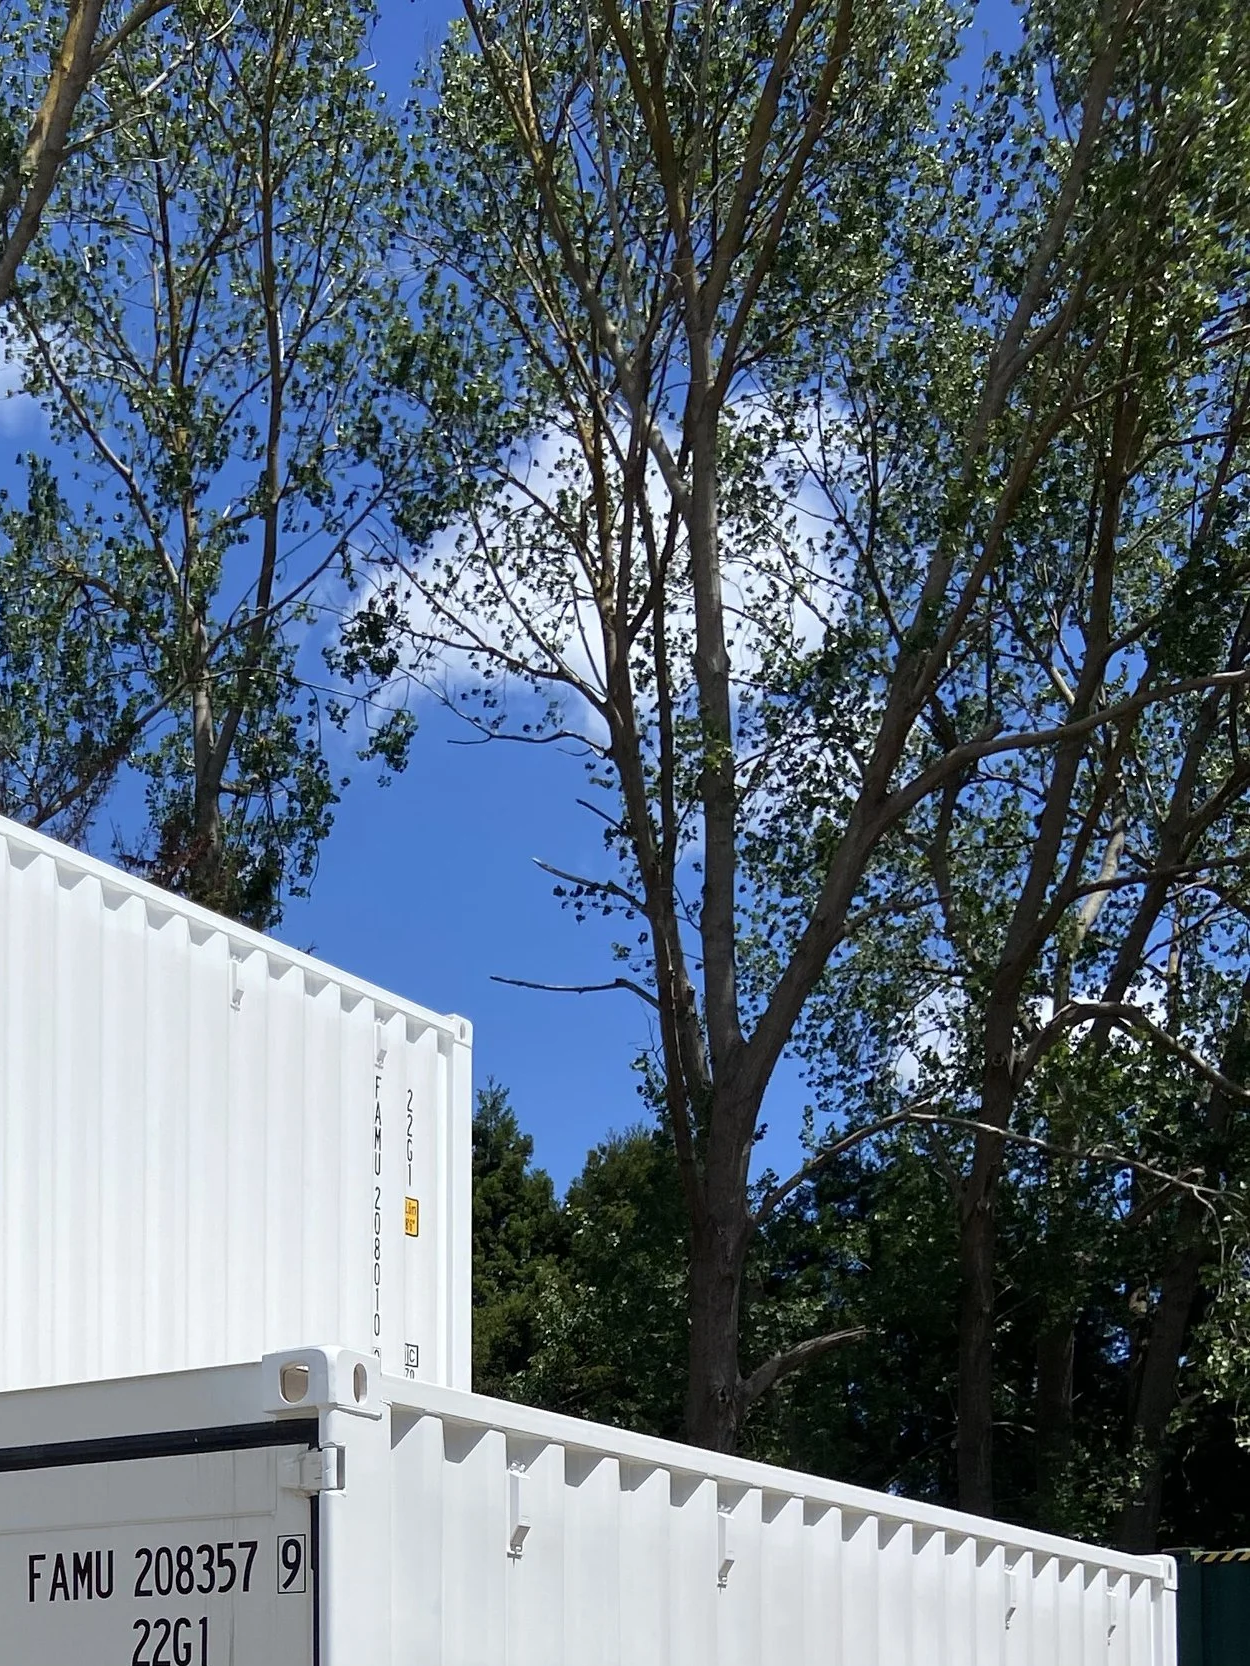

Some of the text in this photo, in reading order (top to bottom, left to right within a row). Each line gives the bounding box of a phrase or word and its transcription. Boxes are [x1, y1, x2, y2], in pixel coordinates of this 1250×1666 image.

[406, 1089, 414, 1187] 22G1
[373, 1075, 382, 1337] FAMU 208010
[28, 1538, 301, 1602] FAMU 208357 9
